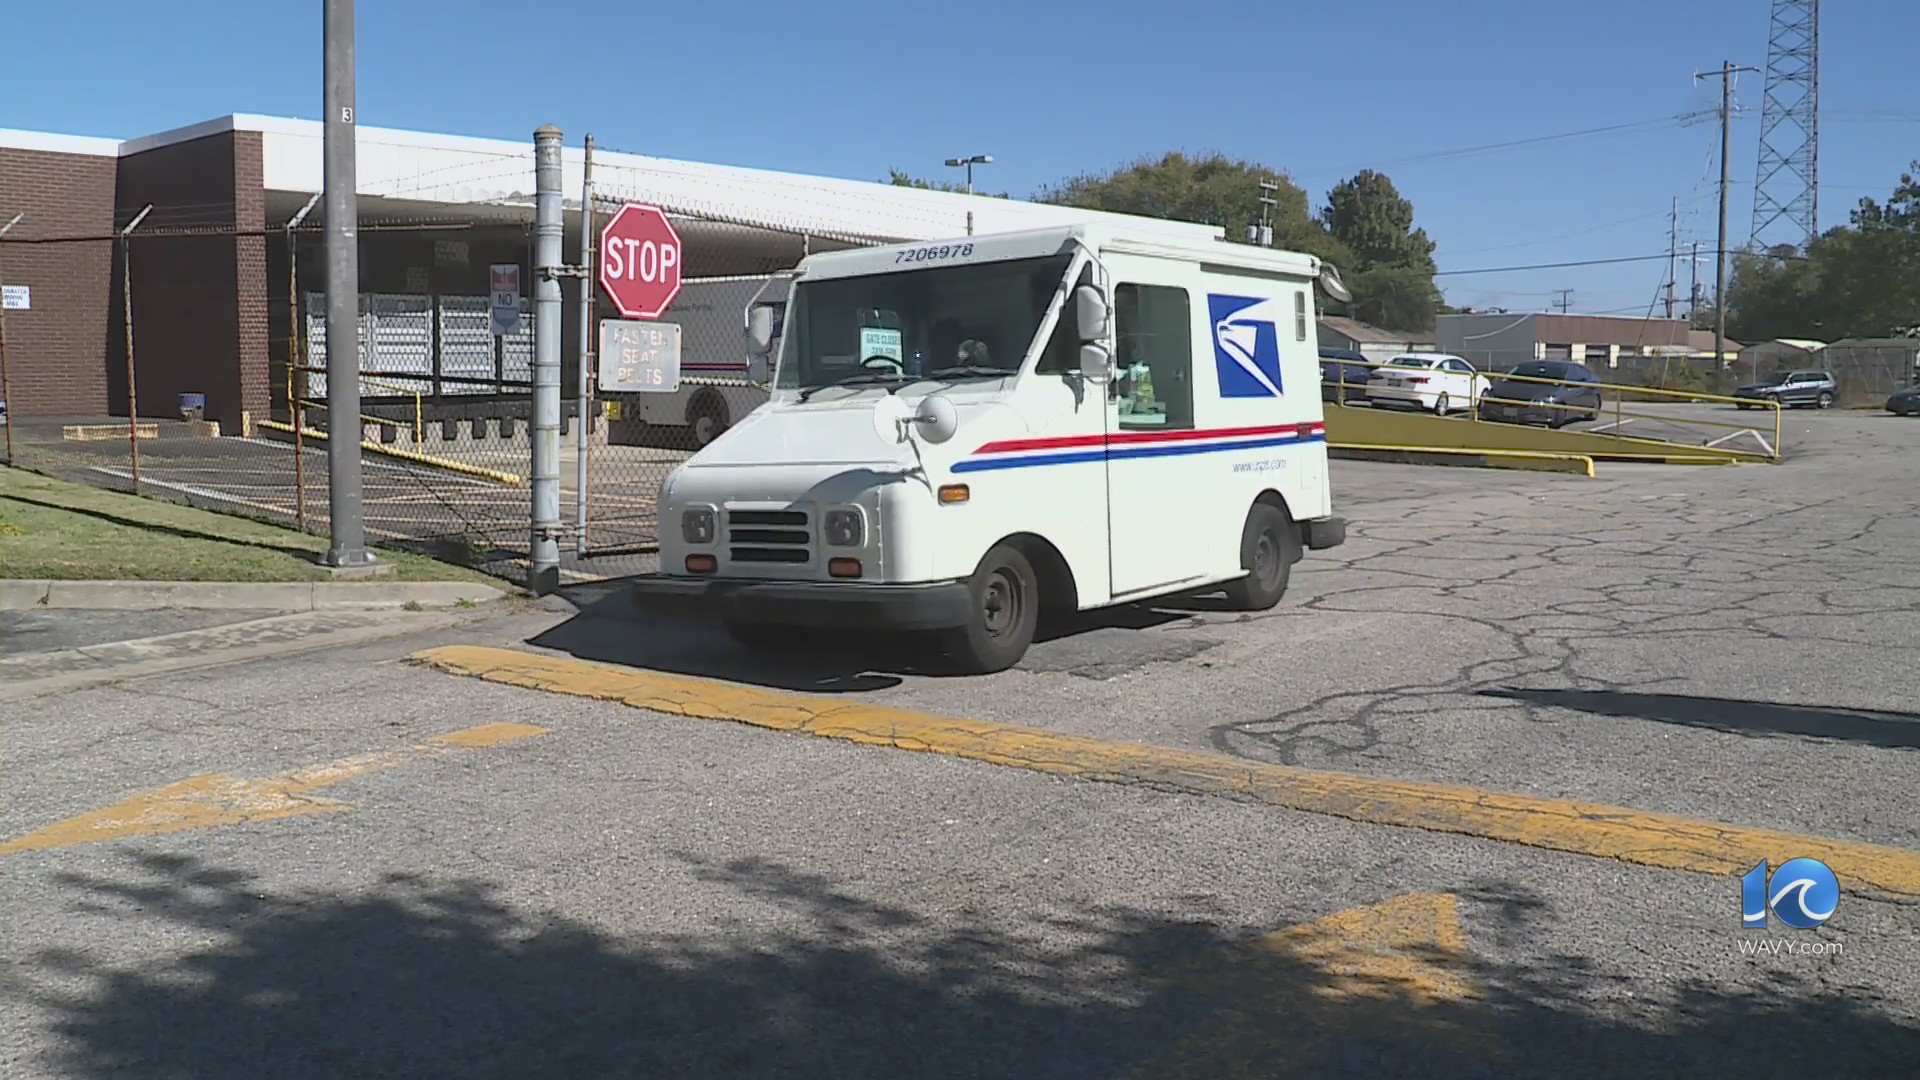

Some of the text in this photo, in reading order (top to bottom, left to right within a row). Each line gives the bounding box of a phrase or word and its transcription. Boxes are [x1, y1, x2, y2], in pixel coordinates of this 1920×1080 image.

[344, 108, 351, 122] 3
[606, 236, 676, 284] STOP
[896, 243, 974, 264] 7206978
[498, 293, 513, 306] NO
[623, 348, 658, 364] SEAT
[617, 367, 662, 385] BELTS
